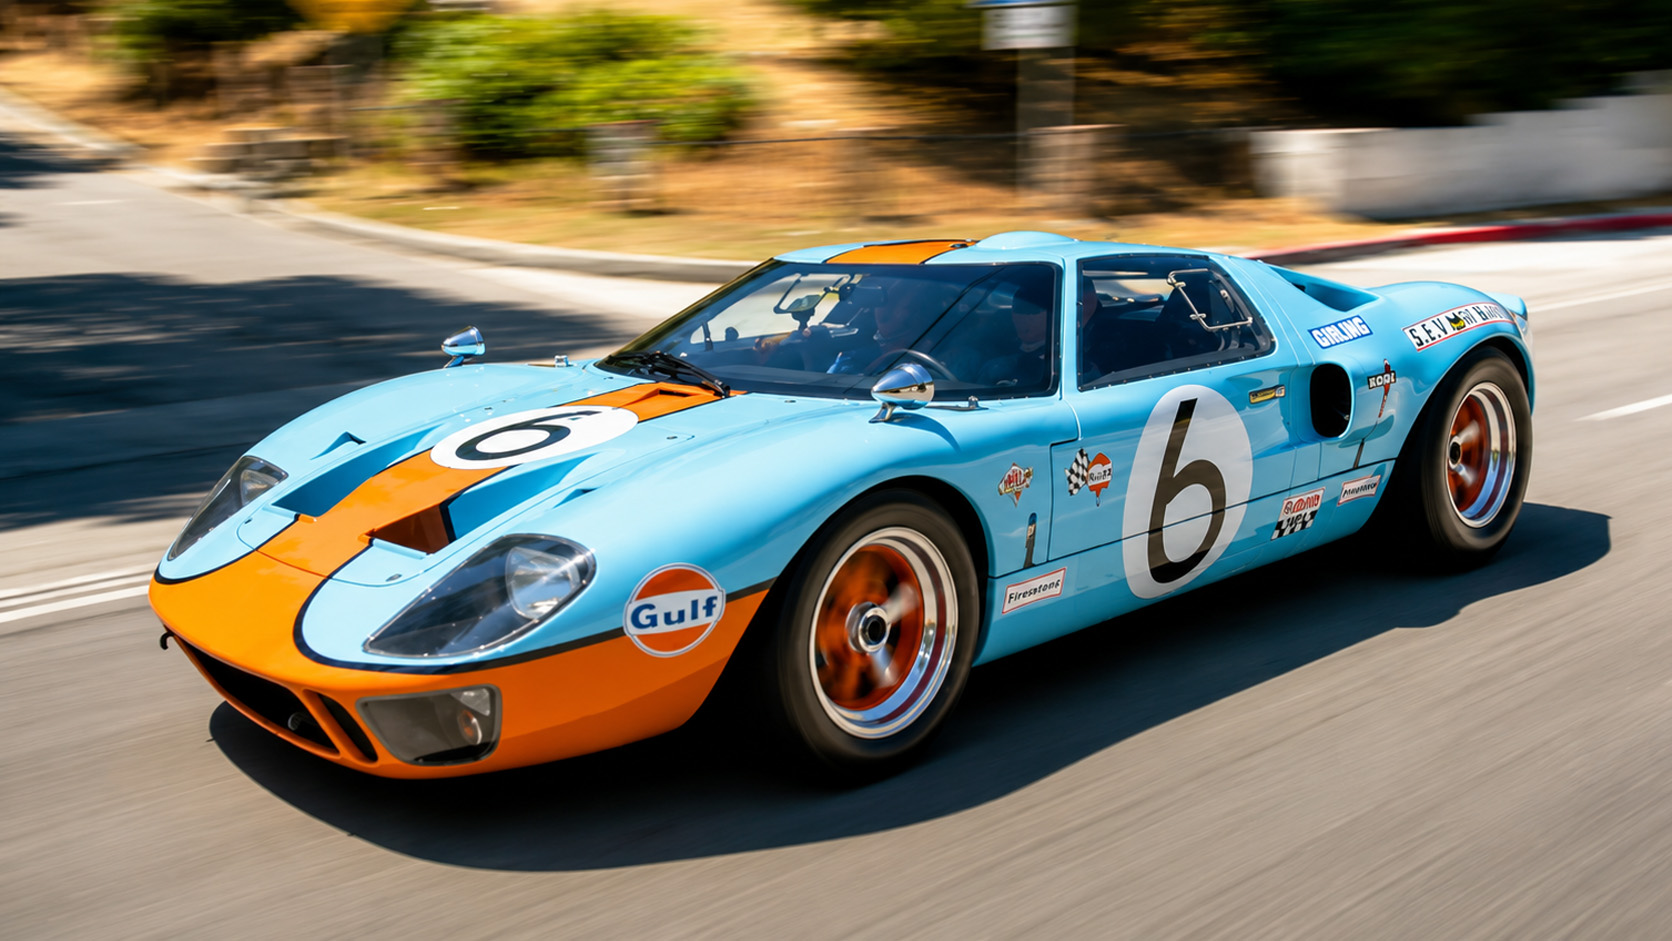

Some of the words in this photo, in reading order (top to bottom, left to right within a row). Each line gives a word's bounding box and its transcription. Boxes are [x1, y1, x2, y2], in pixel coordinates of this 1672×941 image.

[1311, 316, 1371, 348] GIRLING
[455, 410, 602, 461] 6
[1147, 397, 1227, 584] 6
[630, 595, 718, 629] Gulf
